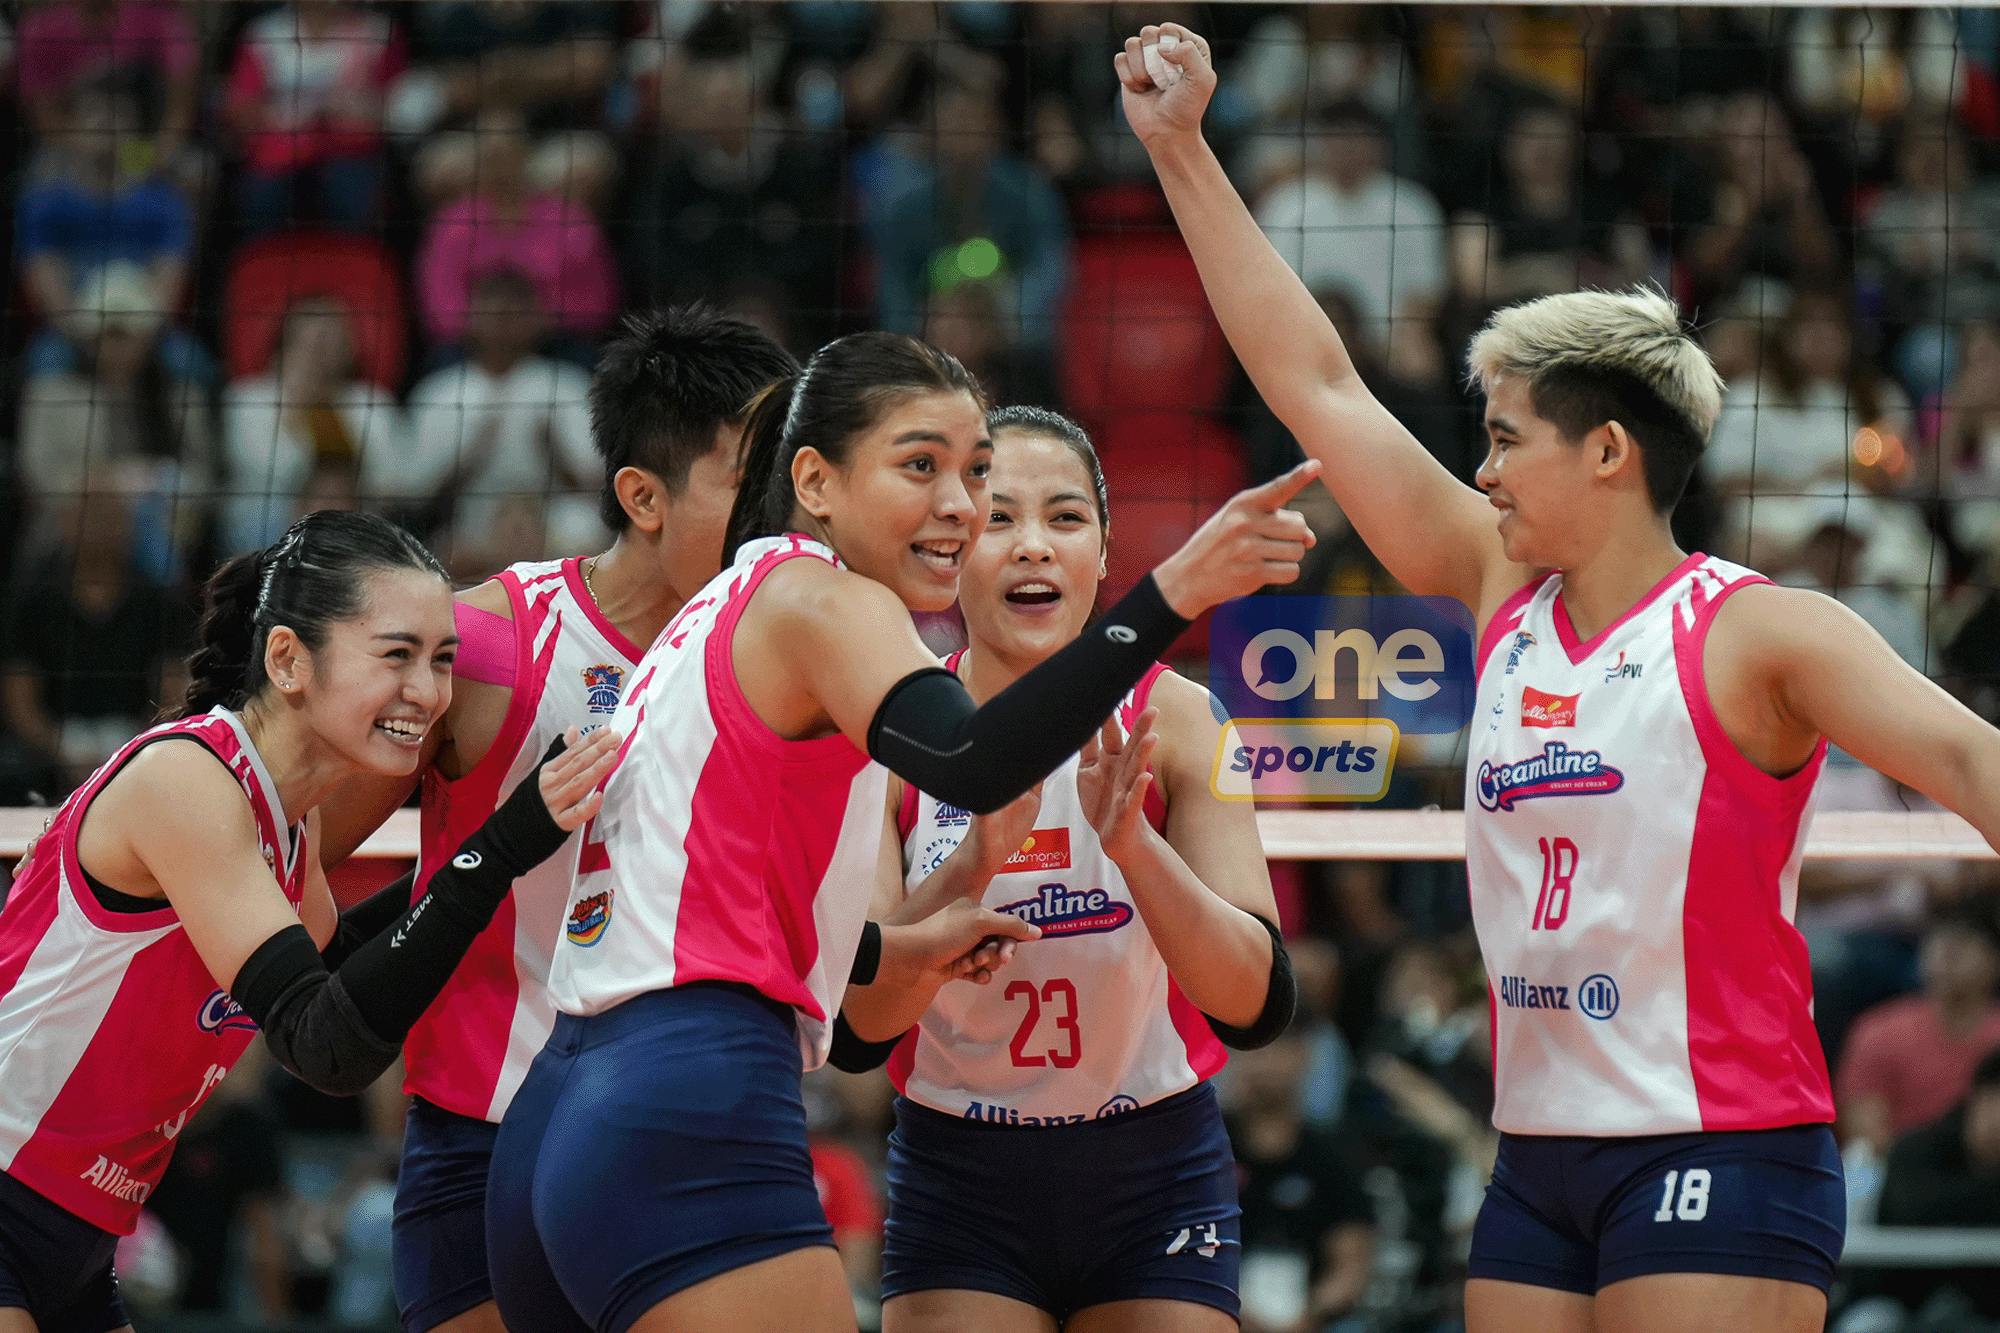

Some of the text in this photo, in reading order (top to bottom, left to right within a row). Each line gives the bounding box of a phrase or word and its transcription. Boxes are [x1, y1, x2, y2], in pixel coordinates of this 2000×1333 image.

[1477, 744, 1600, 810] Creamline
[926, 838, 959, 852] BEYON
[1012, 888, 1105, 920] mline
[1532, 837, 1579, 930] 18
[1501, 975, 1571, 1010] Allianz
[1004, 978, 1081, 1068] 23
[1654, 1168, 1712, 1222] 18
